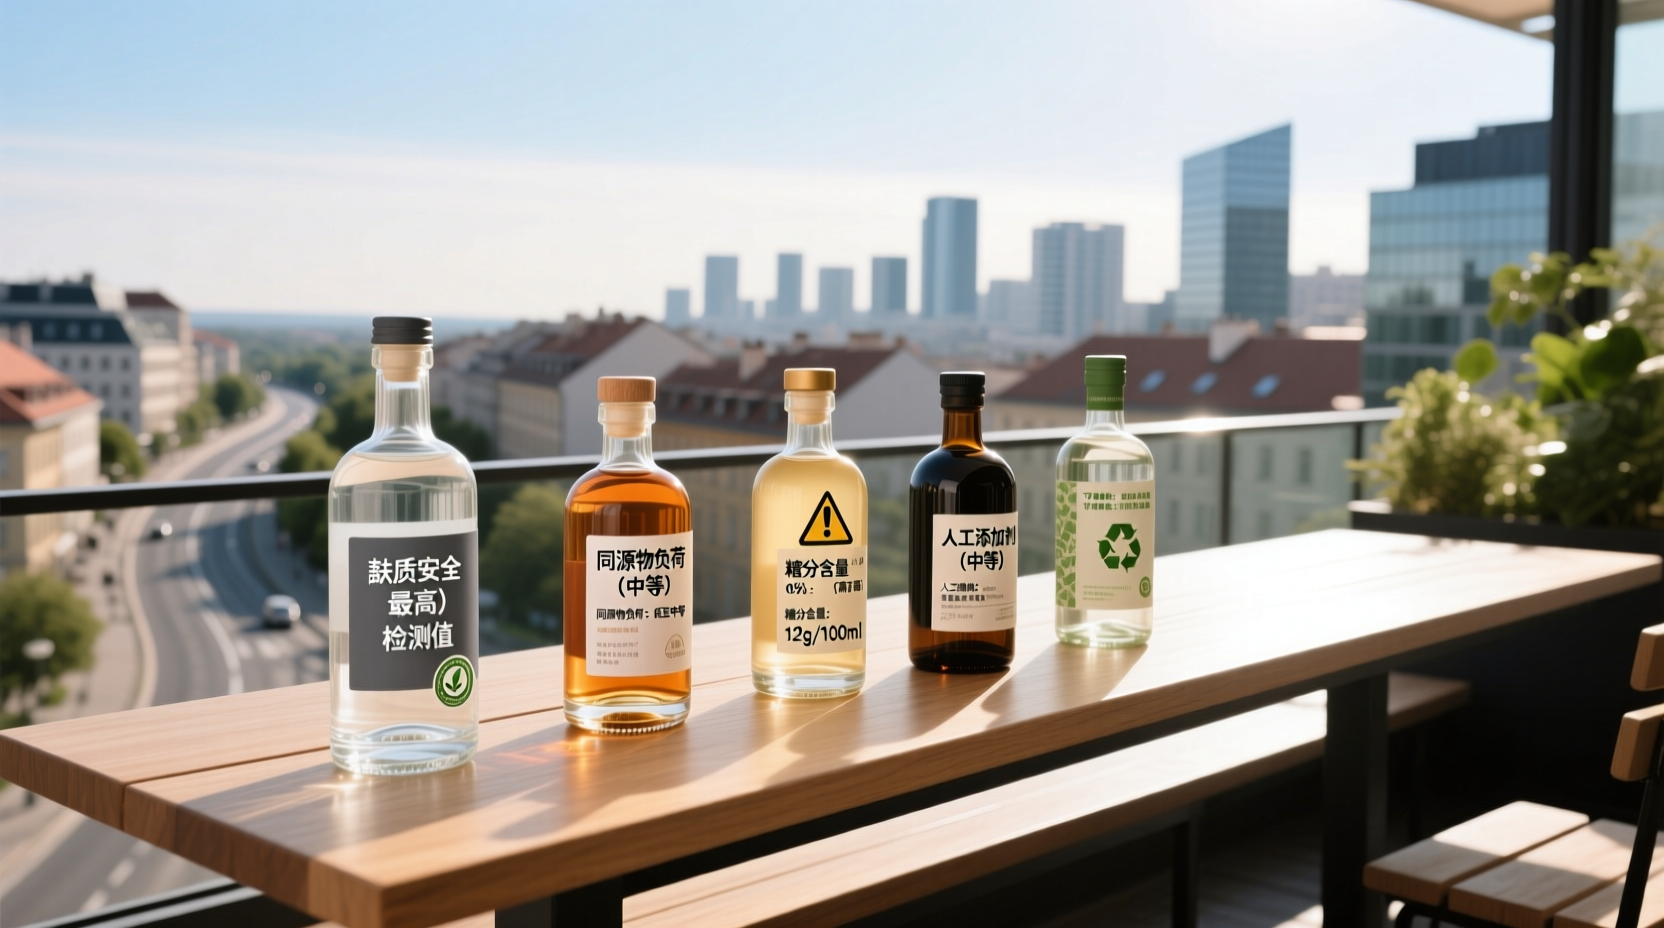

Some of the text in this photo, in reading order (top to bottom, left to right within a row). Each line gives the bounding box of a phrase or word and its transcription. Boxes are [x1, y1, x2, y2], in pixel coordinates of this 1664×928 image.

[597, 546, 685, 572] 同源物负荷
[960, 549, 1004, 572] （中等）
[618, 575, 671, 598] （中等）
[382, 621, 454, 652] 检测值
[785, 621, 862, 647] 12g/100ml
